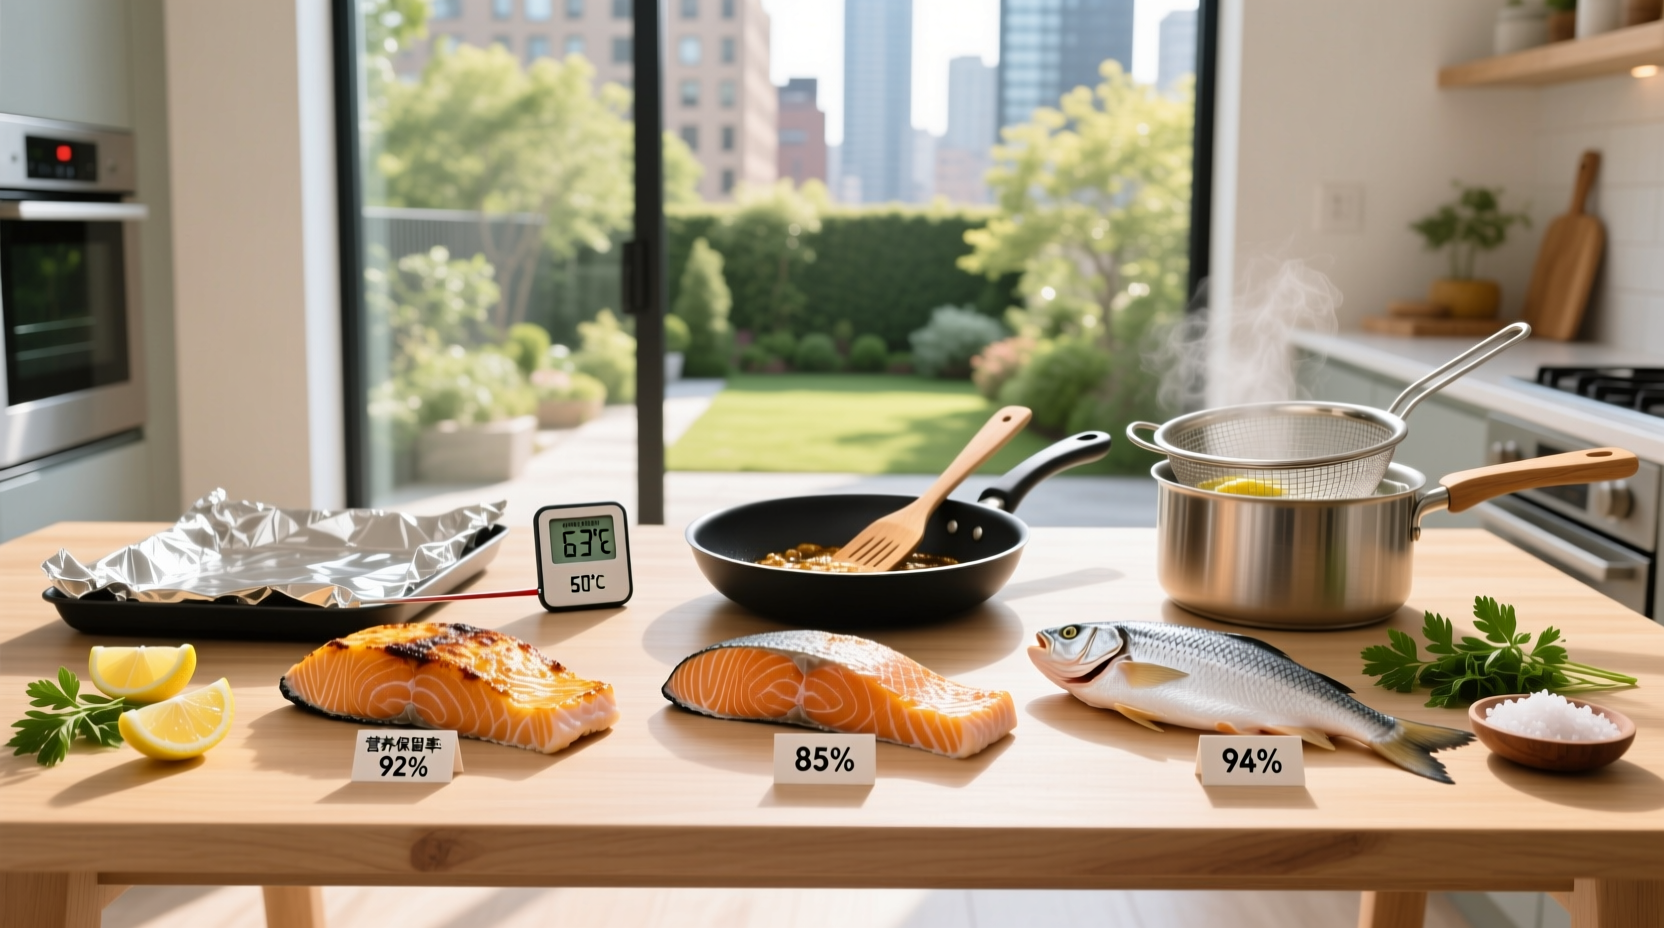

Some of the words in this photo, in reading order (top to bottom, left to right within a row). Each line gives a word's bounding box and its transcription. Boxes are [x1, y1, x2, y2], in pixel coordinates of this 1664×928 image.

[379, 755, 428, 777] 92%
[795, 746, 855, 772] 85%
[1222, 748, 1282, 773] 94%
